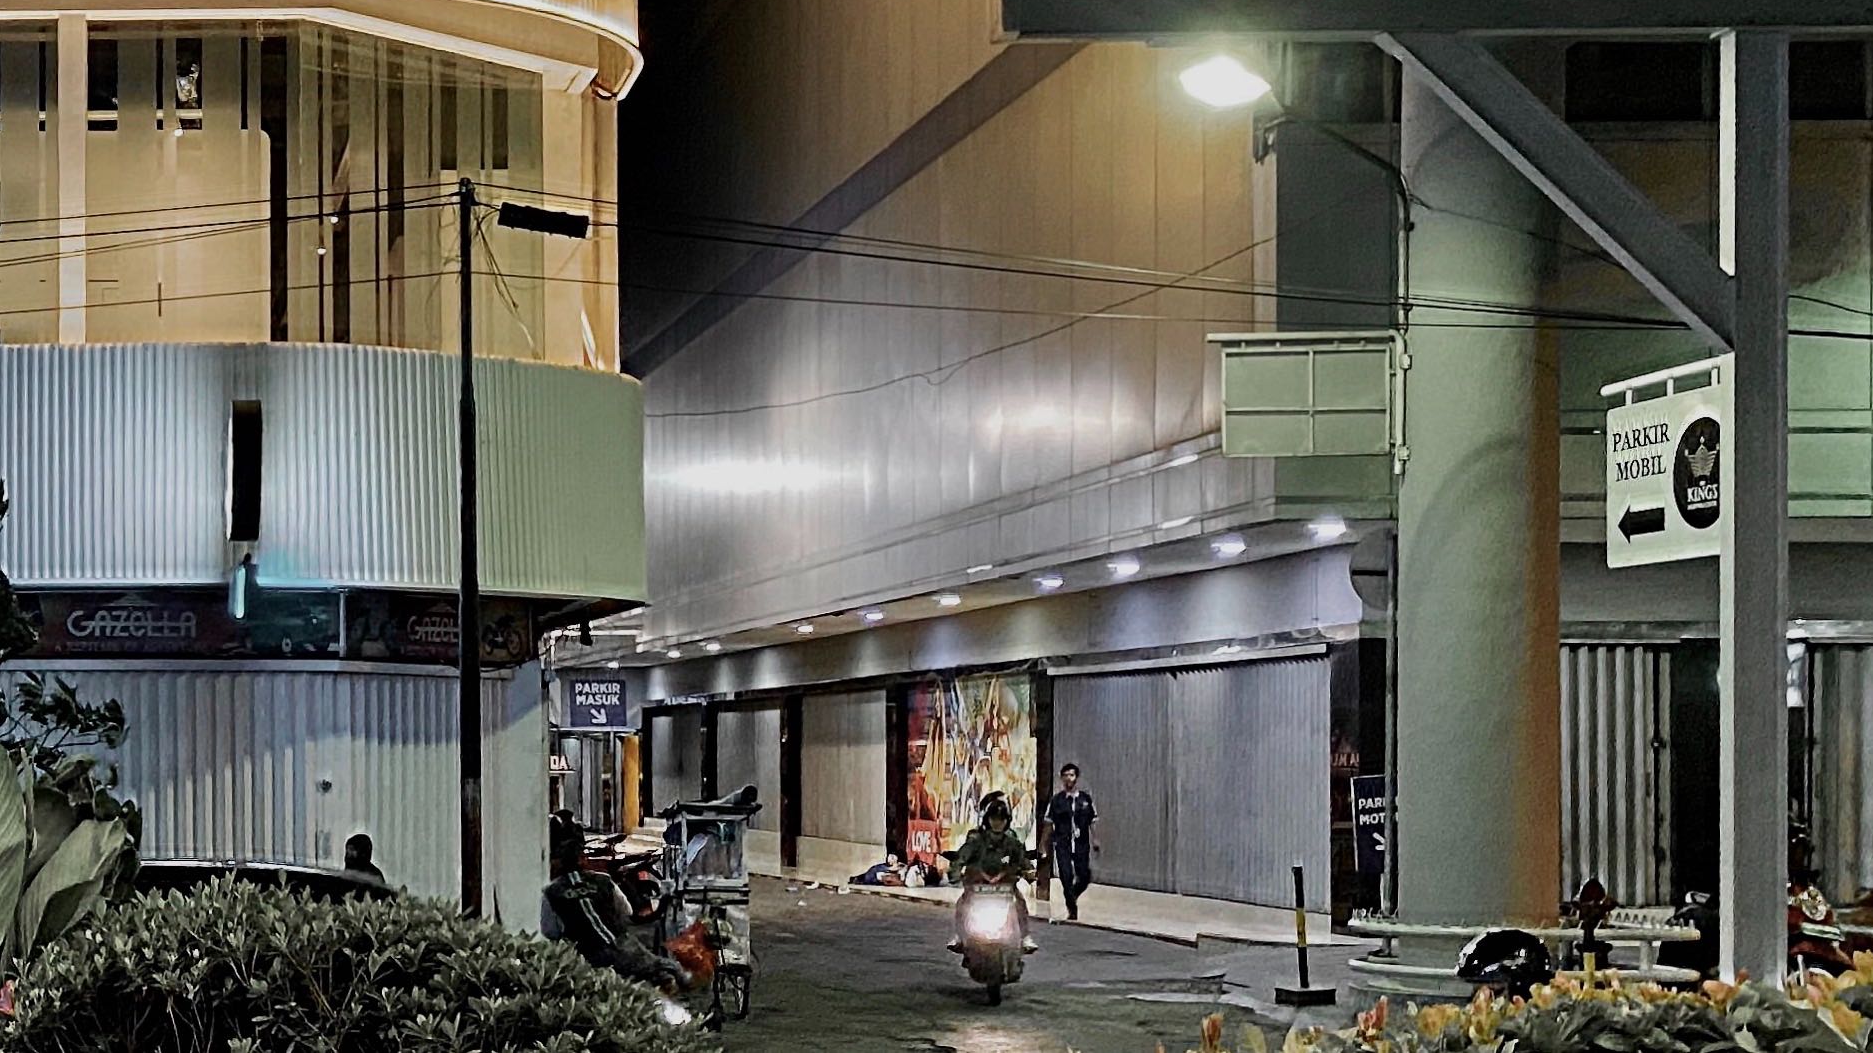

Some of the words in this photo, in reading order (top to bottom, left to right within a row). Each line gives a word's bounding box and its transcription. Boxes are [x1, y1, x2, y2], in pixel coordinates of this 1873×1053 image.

[1612, 422, 1670, 453] PARKIR
[1615, 455, 1667, 483] MOBIL
[574, 682, 621, 694] PARKIR
[574, 694, 620, 706] MASUK
